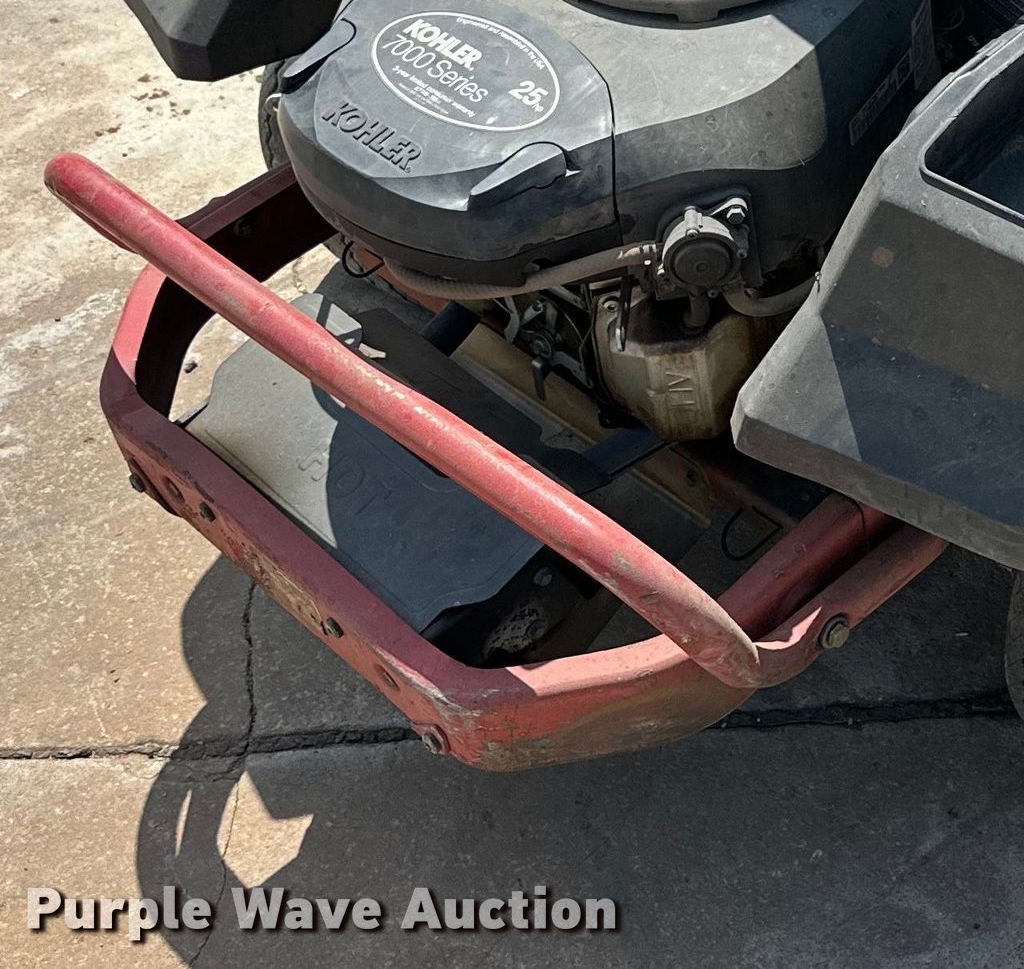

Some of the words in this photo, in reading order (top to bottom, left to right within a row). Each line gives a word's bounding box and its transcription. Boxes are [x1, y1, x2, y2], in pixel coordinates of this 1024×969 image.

[382, 34, 436, 69] 7000
[427, 60, 489, 102] Series
[403, 18, 483, 70] KOHLER
[508, 80, 549, 106] 25
[321, 102, 422, 171] KOHLER
